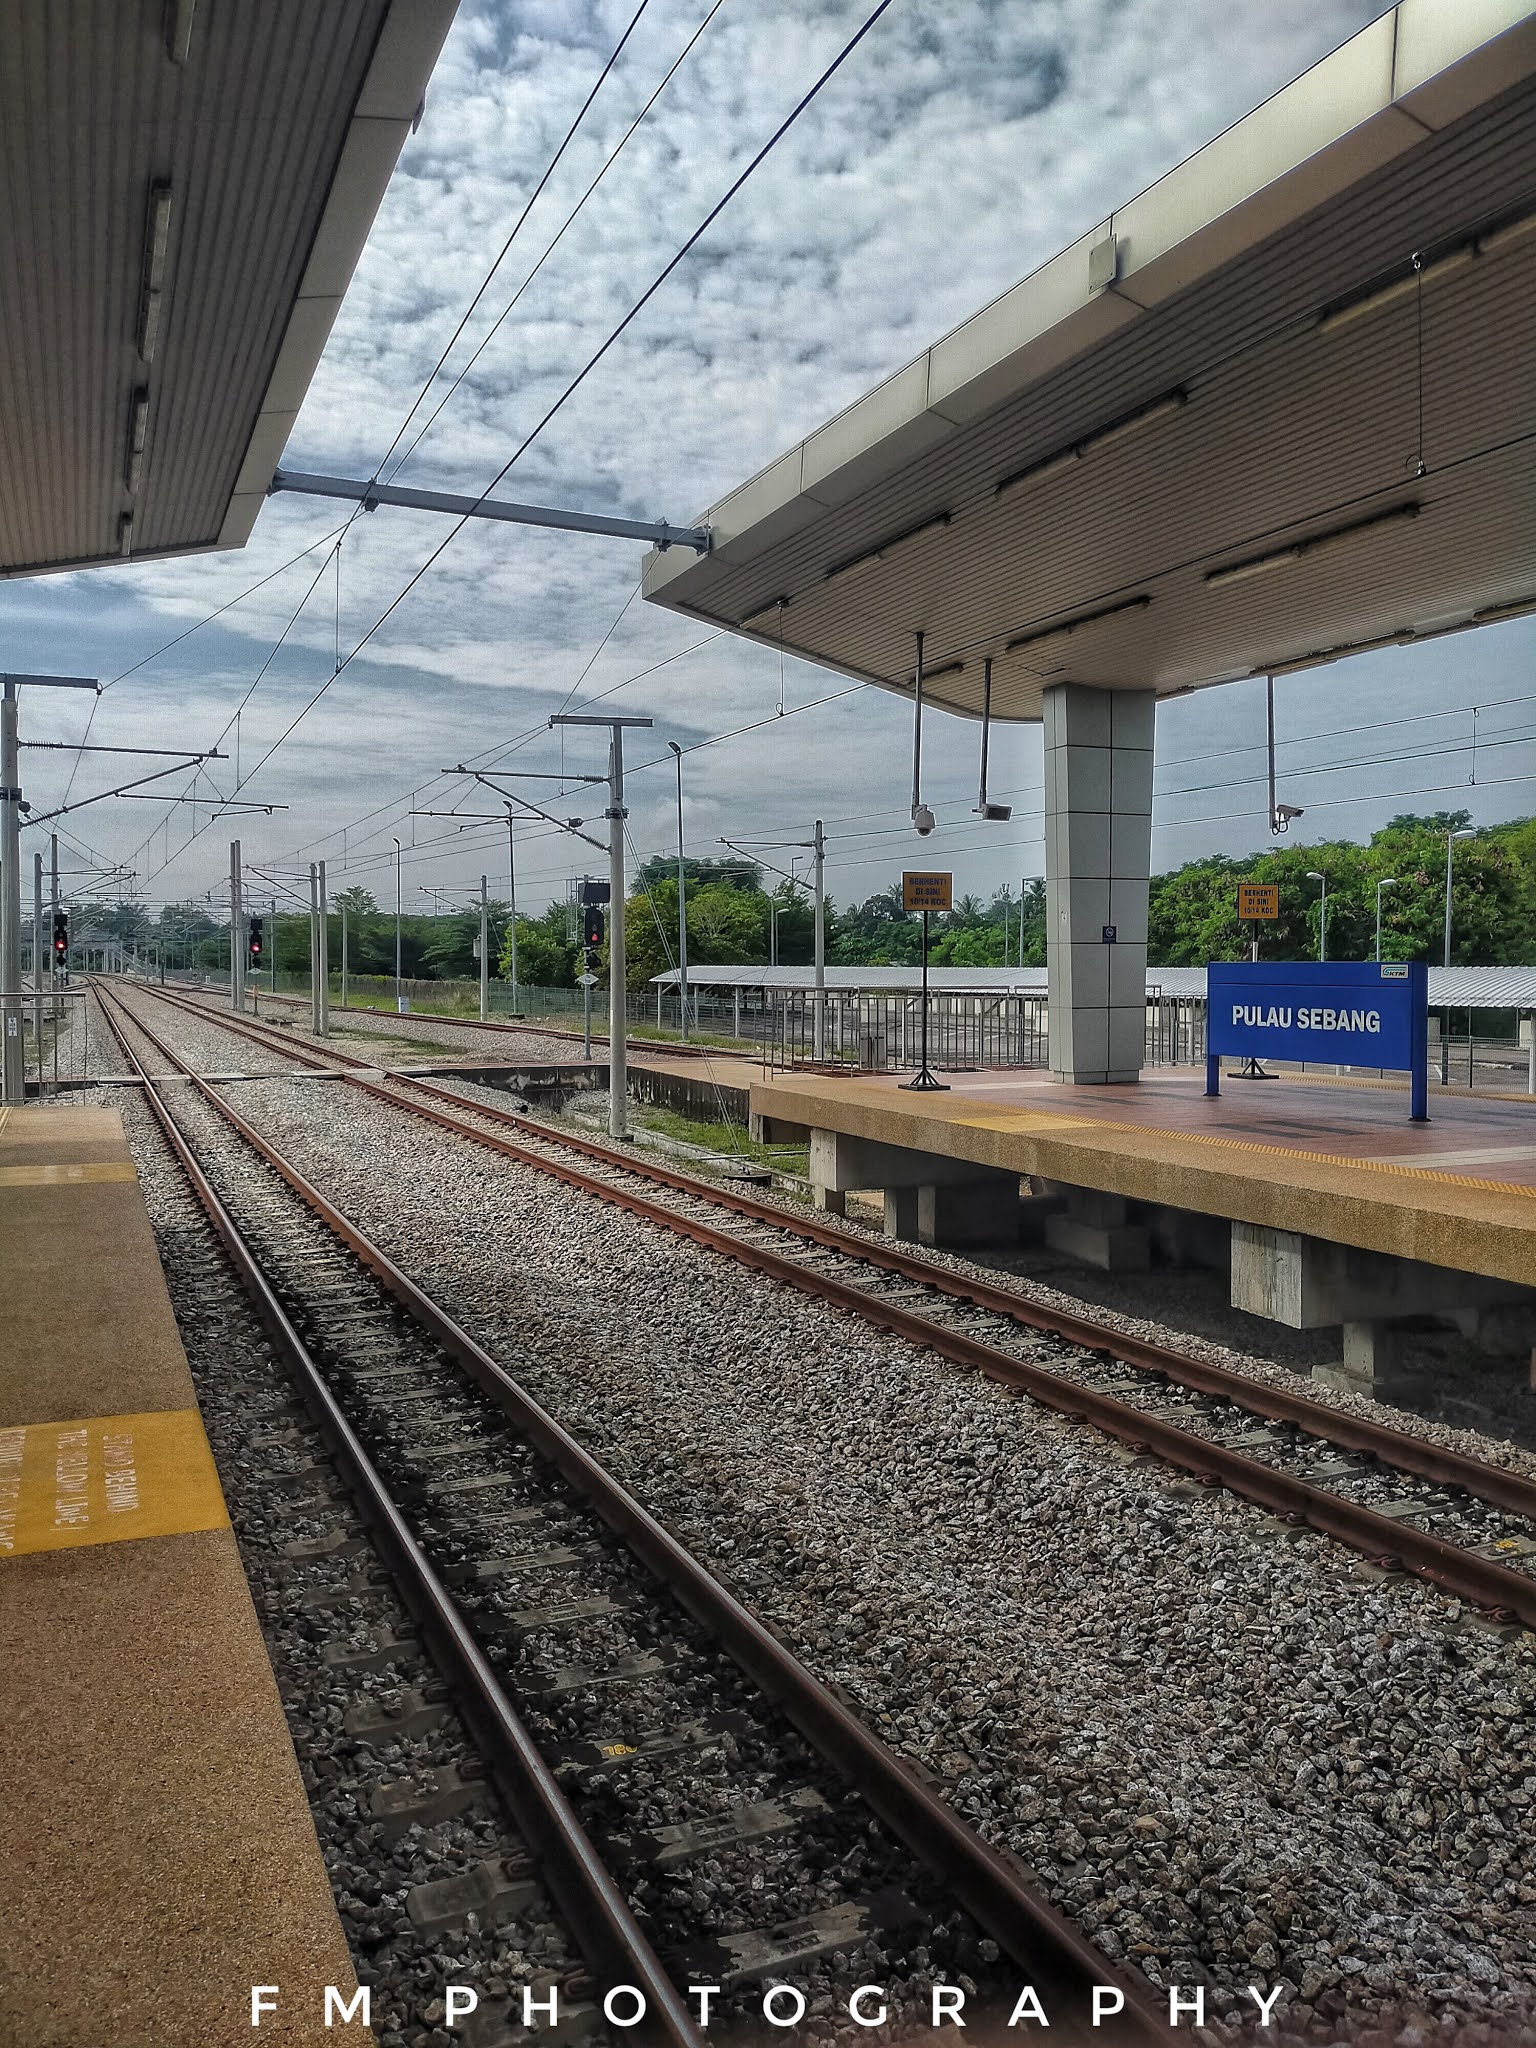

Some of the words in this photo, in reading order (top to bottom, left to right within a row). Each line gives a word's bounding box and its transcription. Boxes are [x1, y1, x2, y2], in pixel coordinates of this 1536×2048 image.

[931, 898, 946, 906] KOC
[1244, 889, 1274, 897] BERHENTI
[1232, 1005, 1292, 1028] PULAU
[1297, 1007, 1381, 1033] SEBANG
[57, 1429, 88, 1450] THE
[103, 1434, 135, 1467] STAND
[56, 1451, 88, 1493] YELLOW
[105, 1469, 139, 1513] BEHIND
